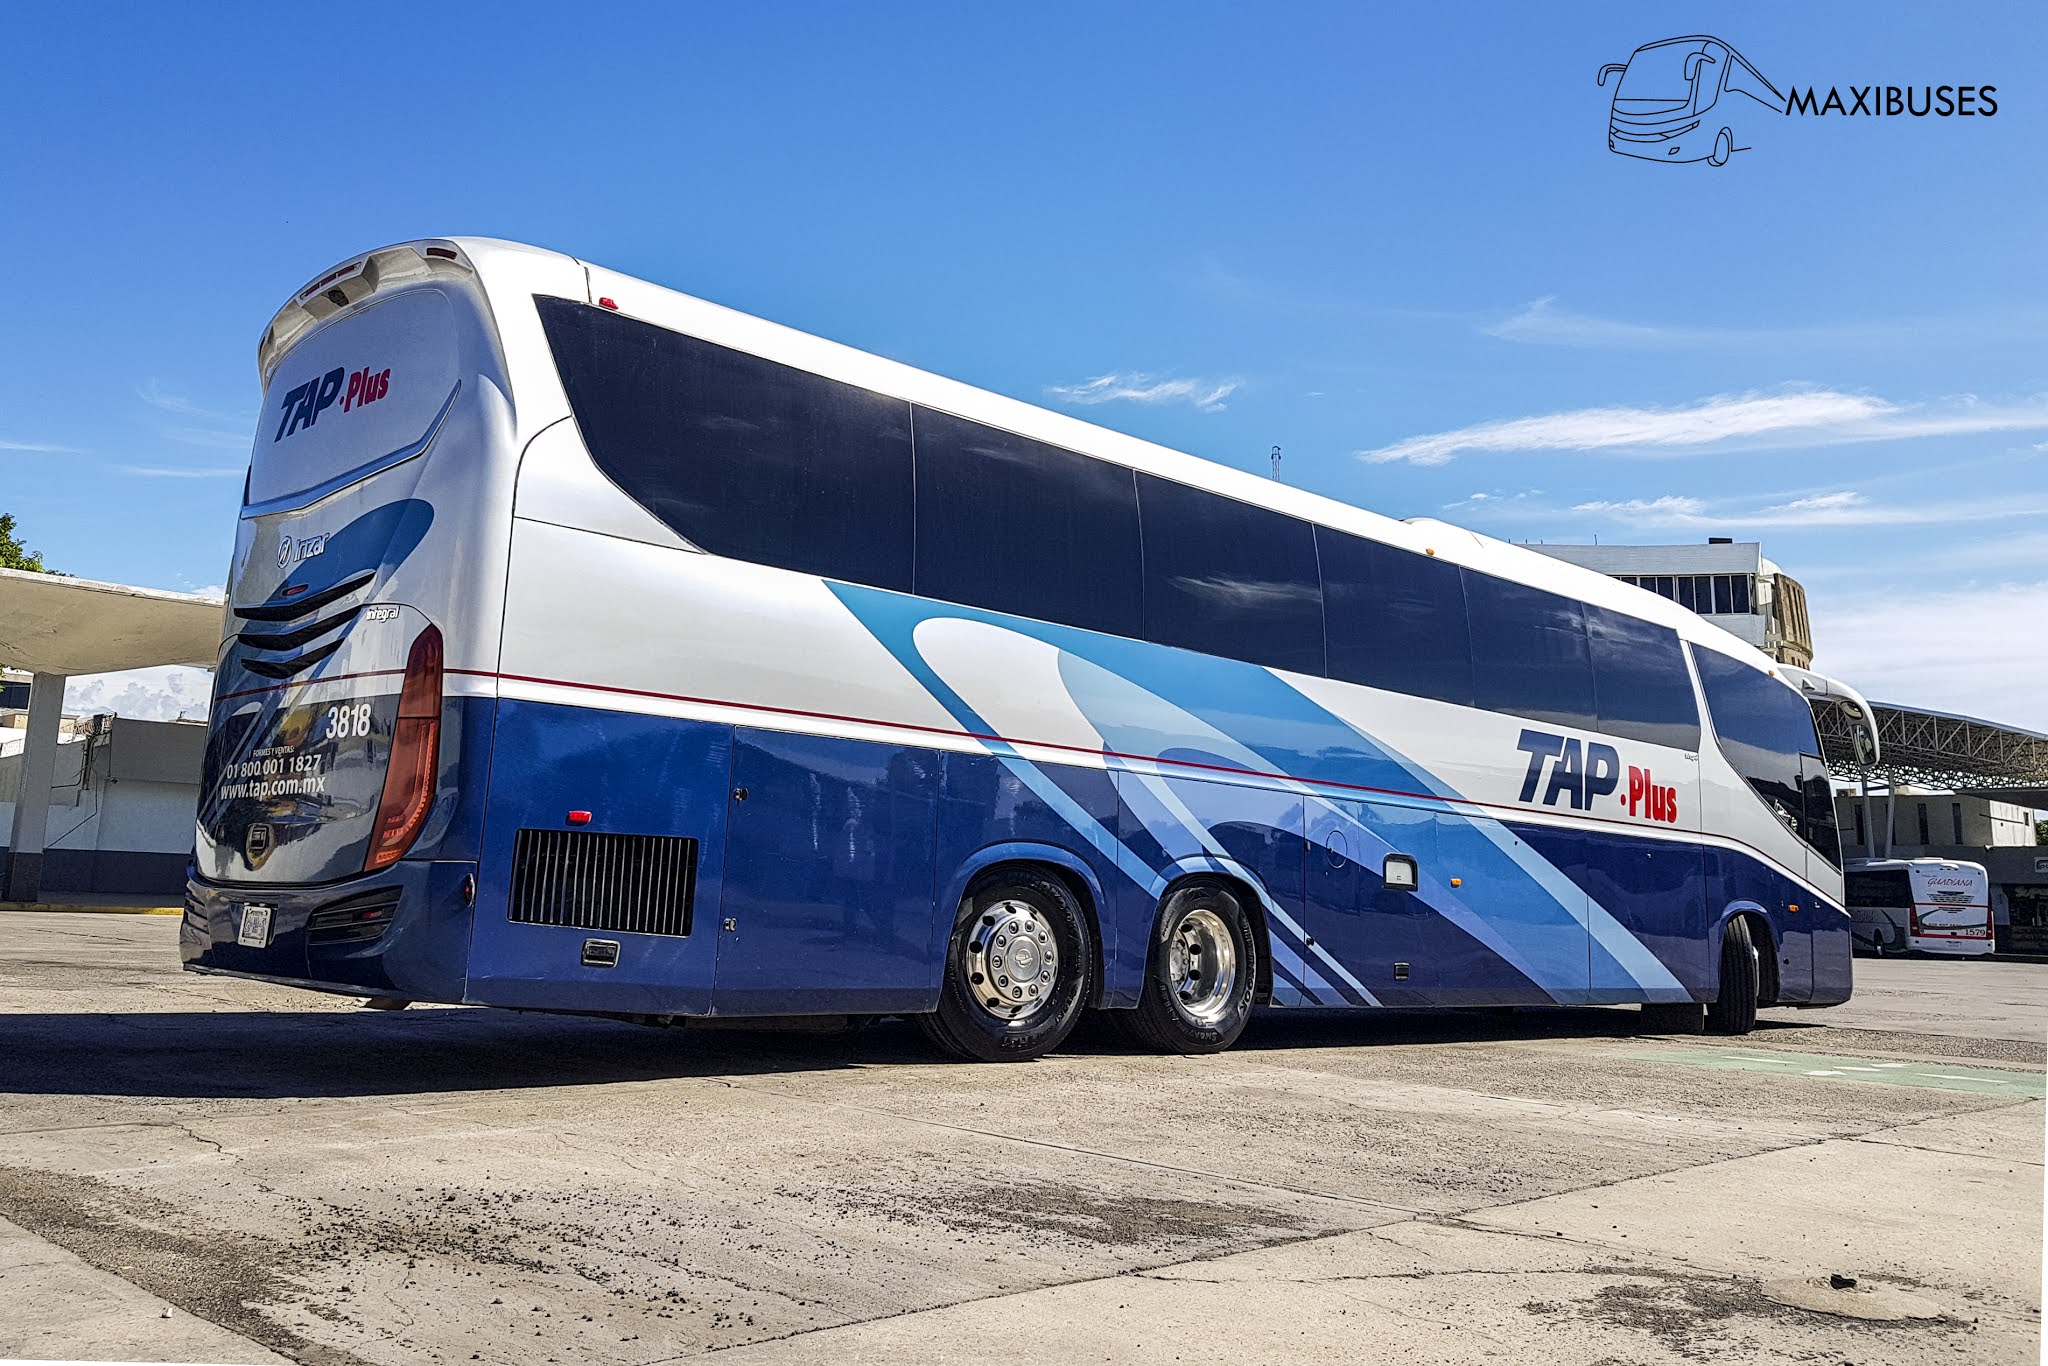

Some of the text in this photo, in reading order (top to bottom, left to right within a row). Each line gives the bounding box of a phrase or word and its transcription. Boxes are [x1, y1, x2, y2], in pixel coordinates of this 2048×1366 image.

[325, 703, 372, 739] 3818
[226, 754, 322, 779] 01 800 001 1827
[220, 776, 326, 801] www.tap.com.mx
[1927, 878, 1973, 887] GUADIANA
